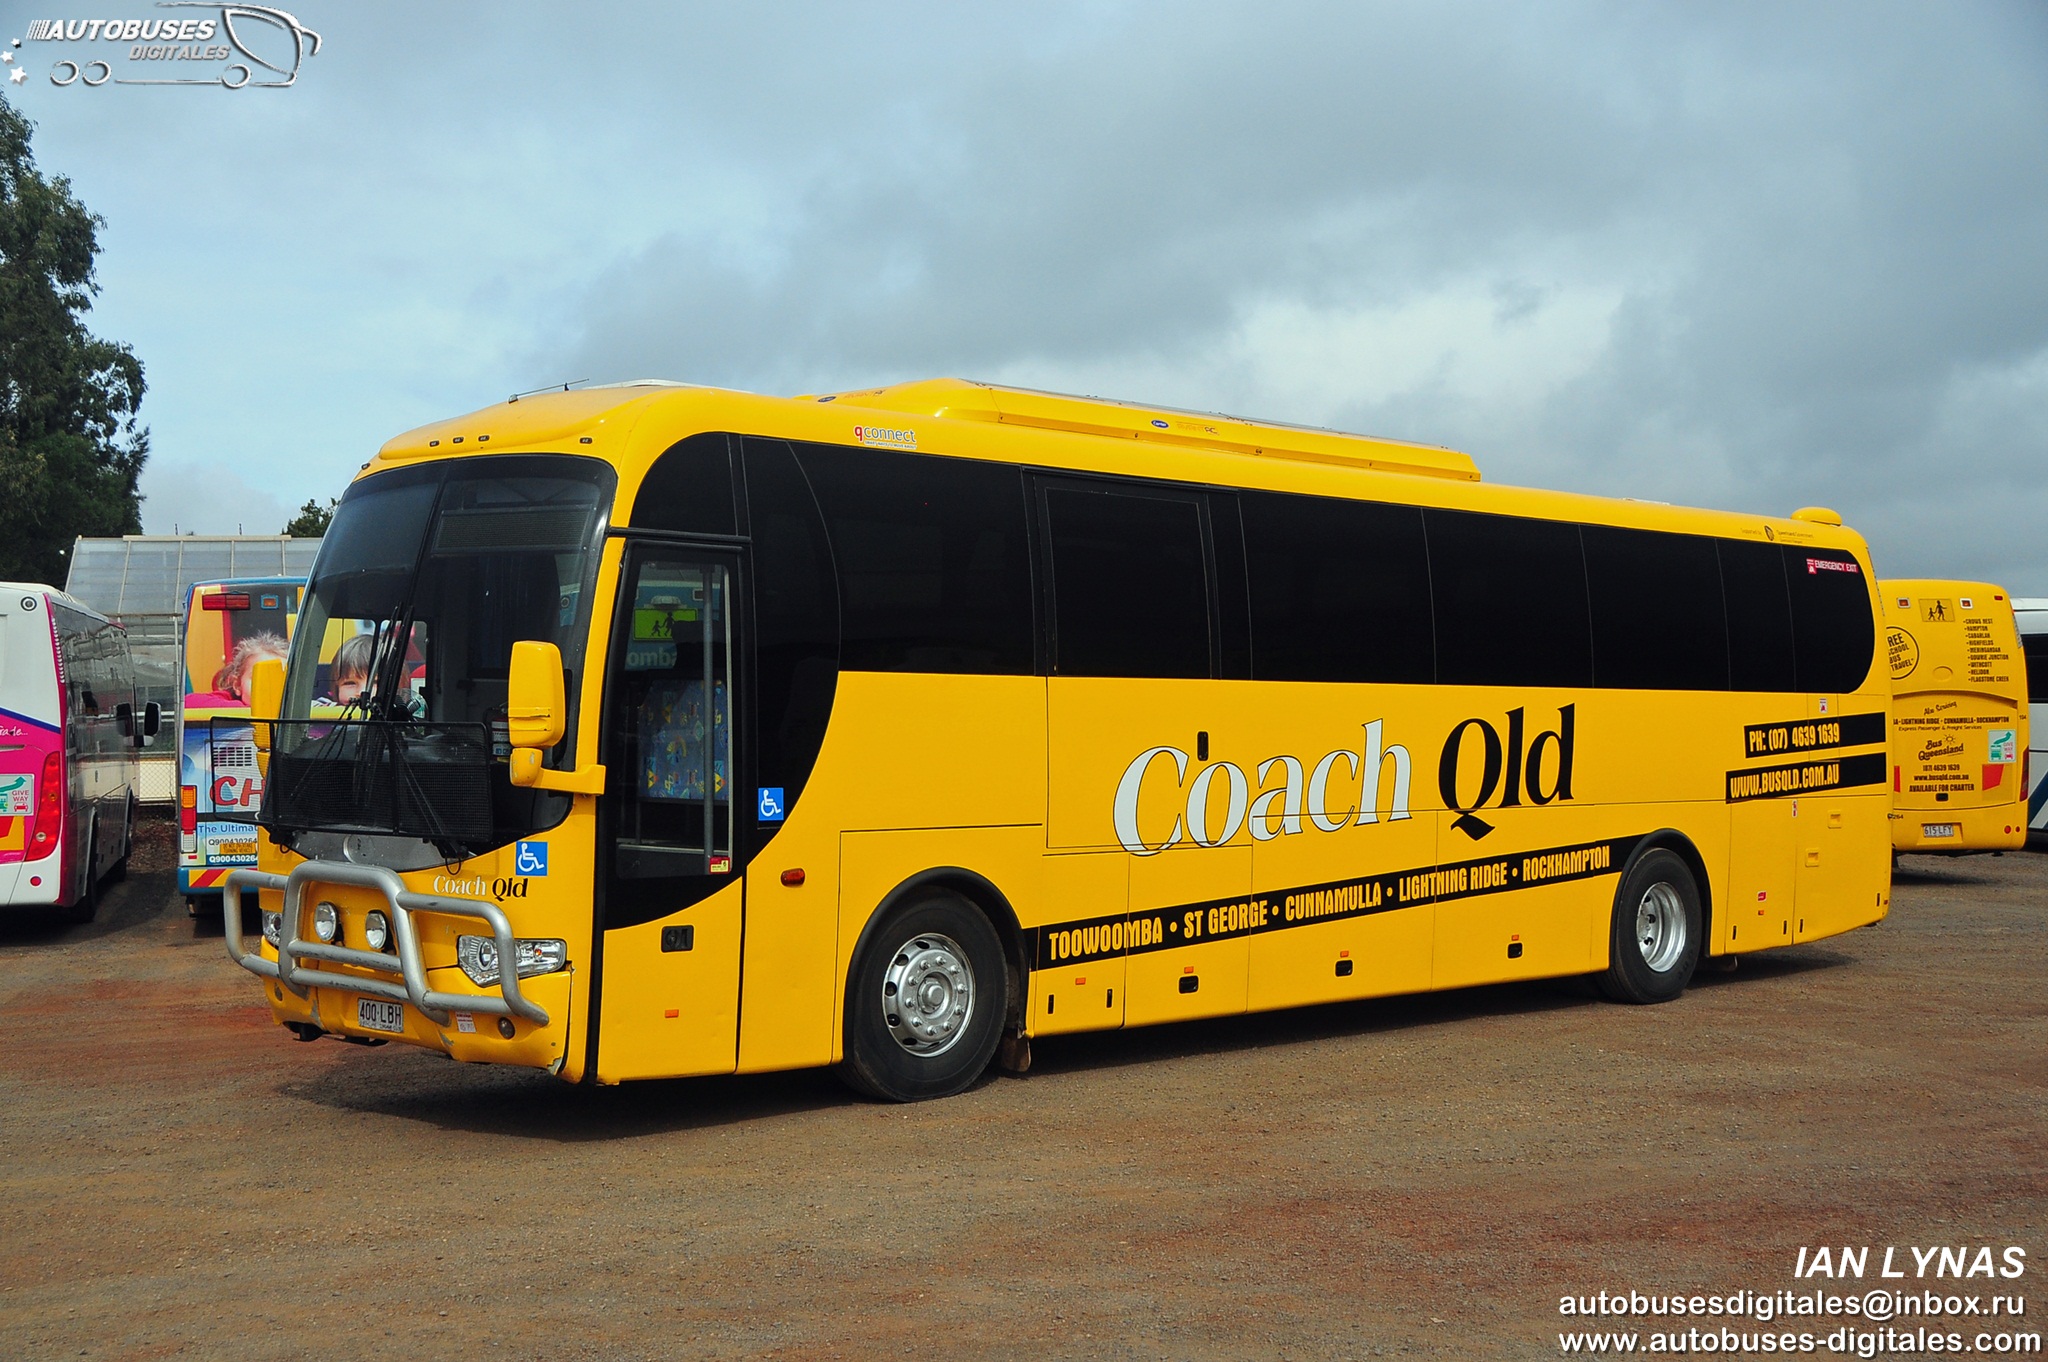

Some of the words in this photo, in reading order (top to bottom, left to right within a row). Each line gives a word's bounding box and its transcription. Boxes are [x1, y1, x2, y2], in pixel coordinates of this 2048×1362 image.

[855, 426, 915, 442] qconnect
[1815, 560, 1845, 572] EMERGENCY
[1846, 564, 1858, 573] EXIT
[1749, 730, 1766, 752] PH:
[1769, 728, 1788, 750] (07)
[1792, 725, 1816, 747] 4639
[1818, 723, 1840, 744] 1639
[1926, 740, 1942, 750] Bus
[1918, 743, 1964, 761] Queensland
[1113, 718, 1413, 857] Coach
[1438, 702, 1575, 841] Qld
[1730, 764, 1840, 798] WWW.BUSQLD.COM.AU
[1909, 784, 1937, 792] AVAILABLE
[1938, 784, 1949, 792] FOR
[198, 825, 217, 833] The
[433, 875, 486, 896] Coach
[492, 877, 528, 902] Qld
[1048, 916, 1163, 961] TOOWOOMBA
[1184, 909, 1204, 937] ST
[1208, 900, 1267, 934] GEORGE
[1285, 882, 1381, 922] CUNNAMULLA
[1399, 866, 1468, 903] LIGHTNING
[1470, 861, 1508, 892] RIDGE
[1522, 846, 1610, 882] ROCKHAMPTON
